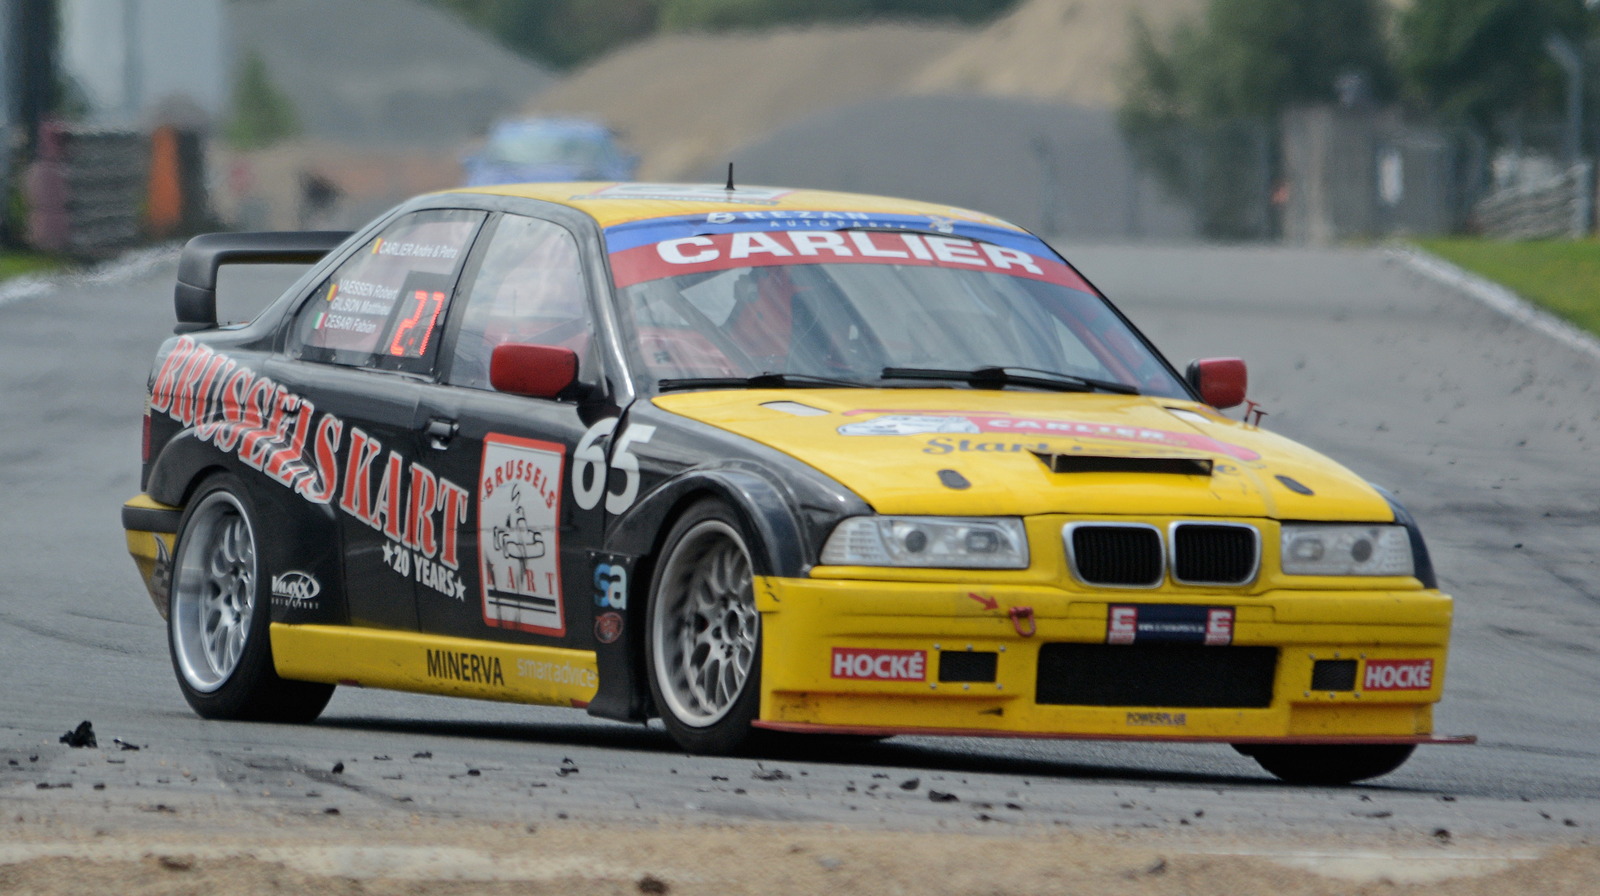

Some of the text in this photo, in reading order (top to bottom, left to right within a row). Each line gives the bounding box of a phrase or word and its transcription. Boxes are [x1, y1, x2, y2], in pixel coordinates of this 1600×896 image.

[706, 211, 869, 224] BREZAN
[379, 241, 415, 256] CARLIER
[656, 231, 1044, 276] CARLIER
[338, 279, 376, 297] VAESSEN
[331, 296, 362, 313] GILSON
[324, 313, 354, 331] CESARI
[987, 418, 1165, 440] CARLIER
[572, 416, 657, 516] 65
[484, 459, 555, 509] BRUSSELS
[393, 545, 455, 597] 20 YEARS
[486, 563, 555, 596] KART
[427, 649, 505, 686] MINERVA
[833, 651, 924, 679] HOCKÉ
[1365, 660, 1432, 688] HOCKÉ
